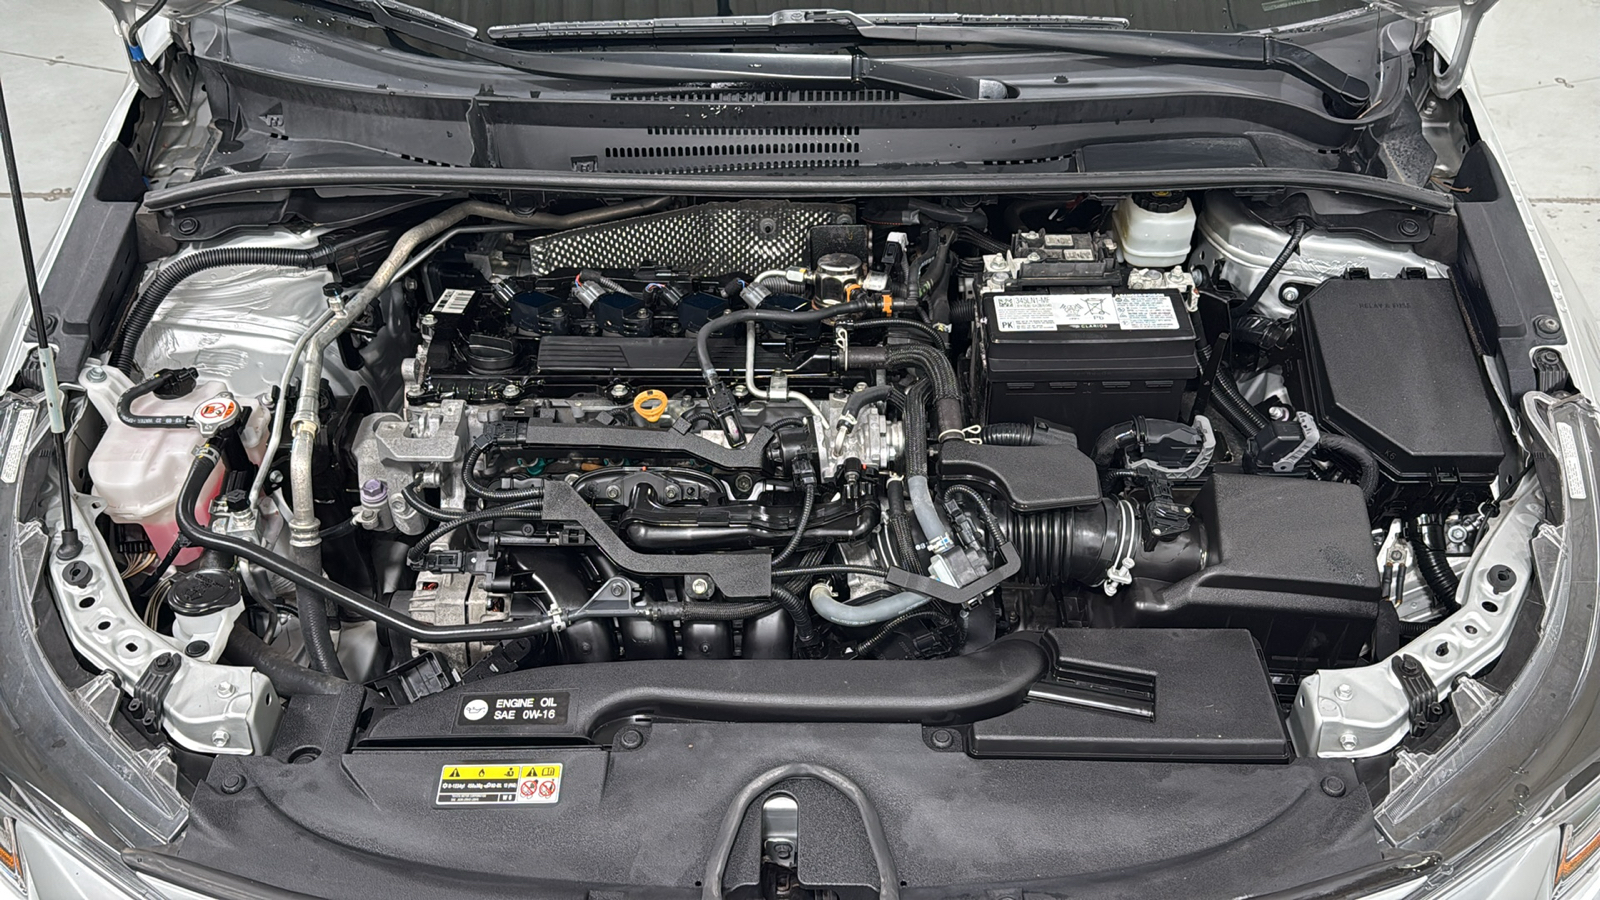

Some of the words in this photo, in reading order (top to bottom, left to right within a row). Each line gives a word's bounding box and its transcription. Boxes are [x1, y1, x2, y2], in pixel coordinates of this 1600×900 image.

[1002, 321, 1013, 329] PK
[496, 698, 535, 708] ENGINE
[540, 697, 557, 707] OIL
[494, 710, 516, 719] SAE
[522, 709, 556, 719] 0W-16
